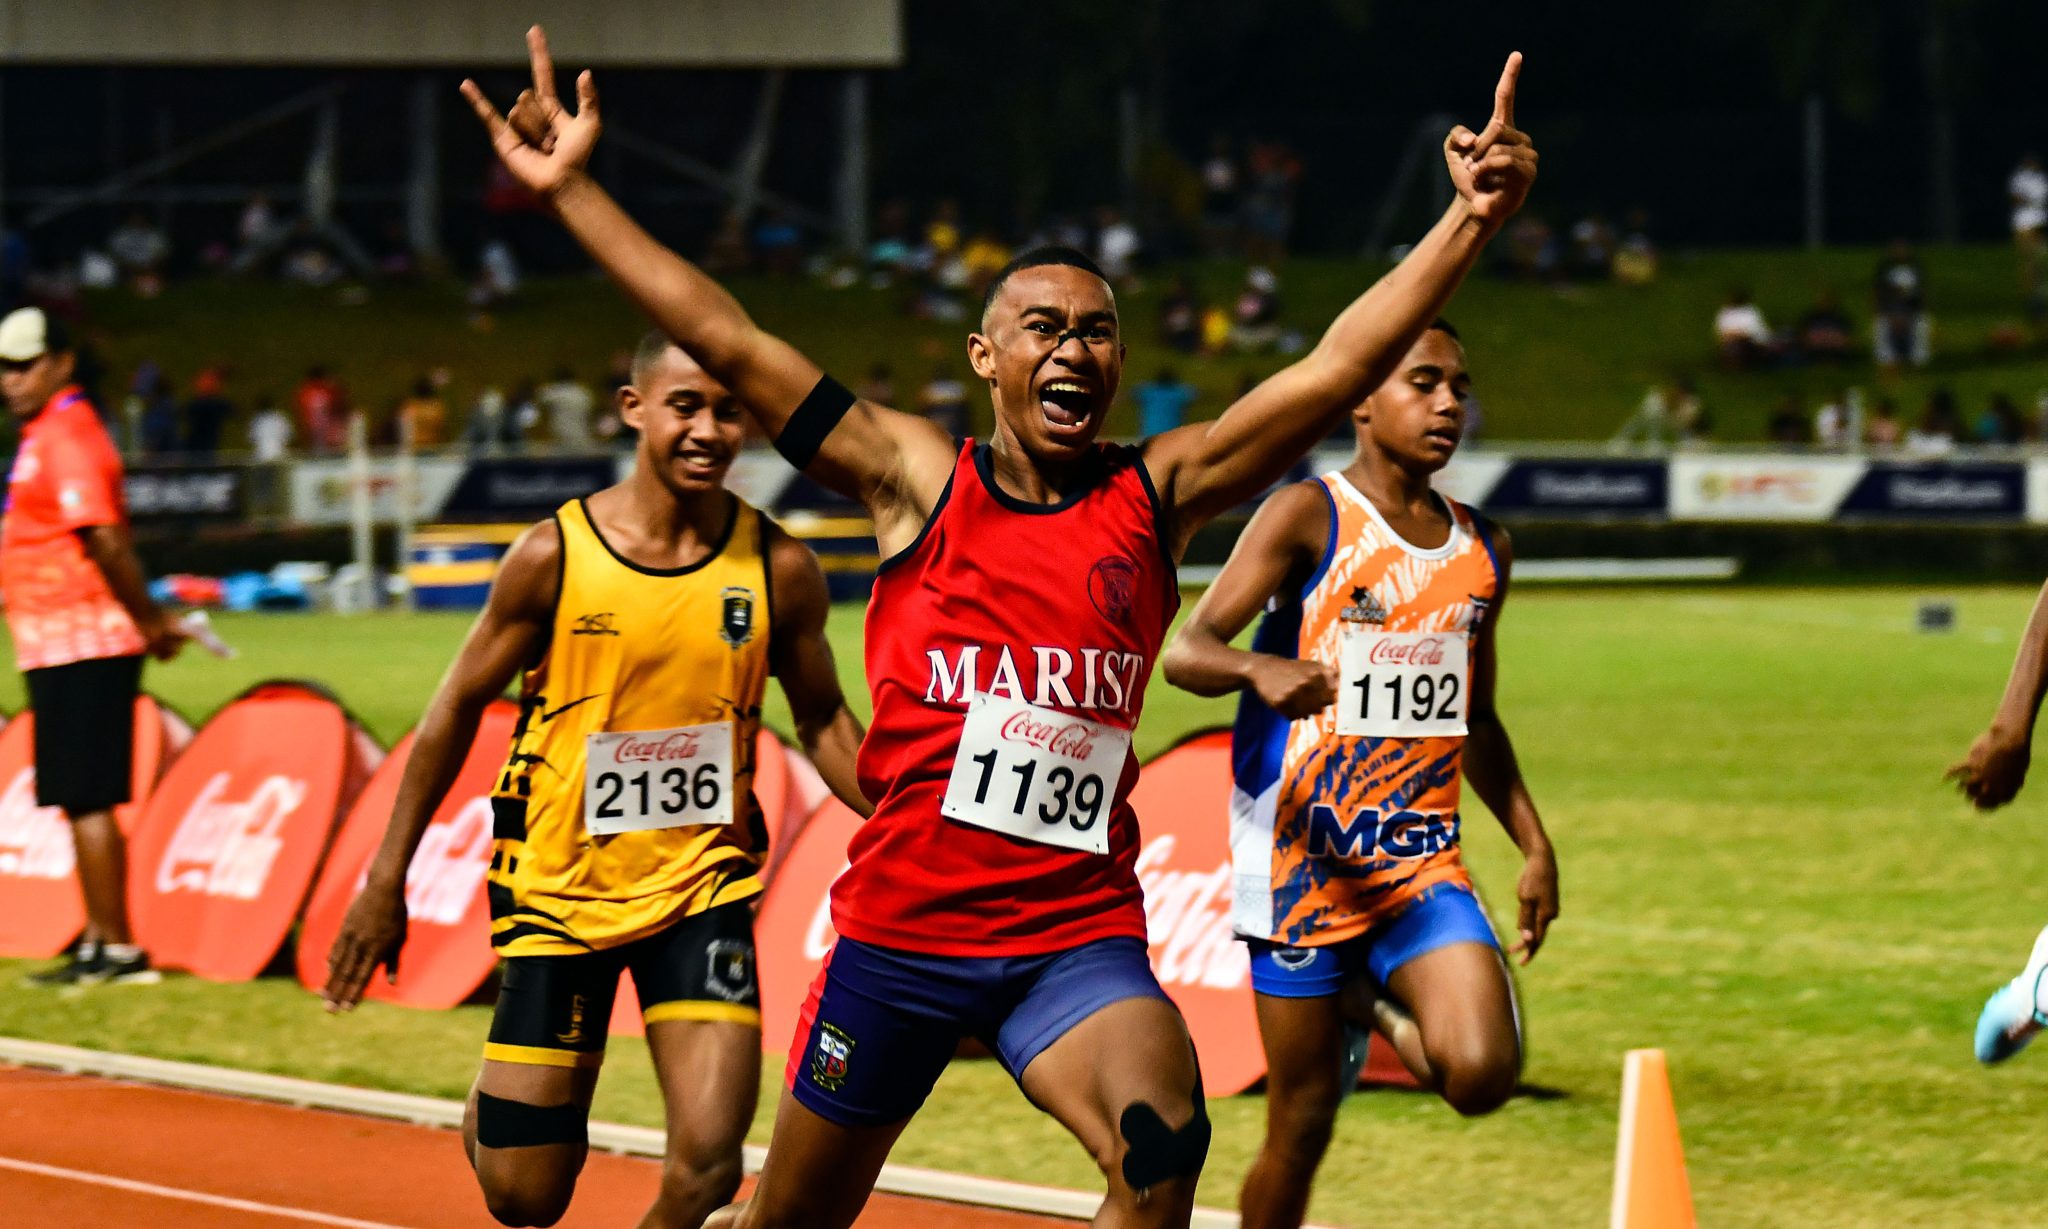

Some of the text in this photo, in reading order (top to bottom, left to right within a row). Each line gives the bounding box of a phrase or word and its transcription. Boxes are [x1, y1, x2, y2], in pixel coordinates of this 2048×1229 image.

[923, 643, 1144, 714] MARIST
[1352, 672, 1460, 722] 1192
[595, 762, 720, 819] 2136
[972, 748, 1105, 832] 1139
